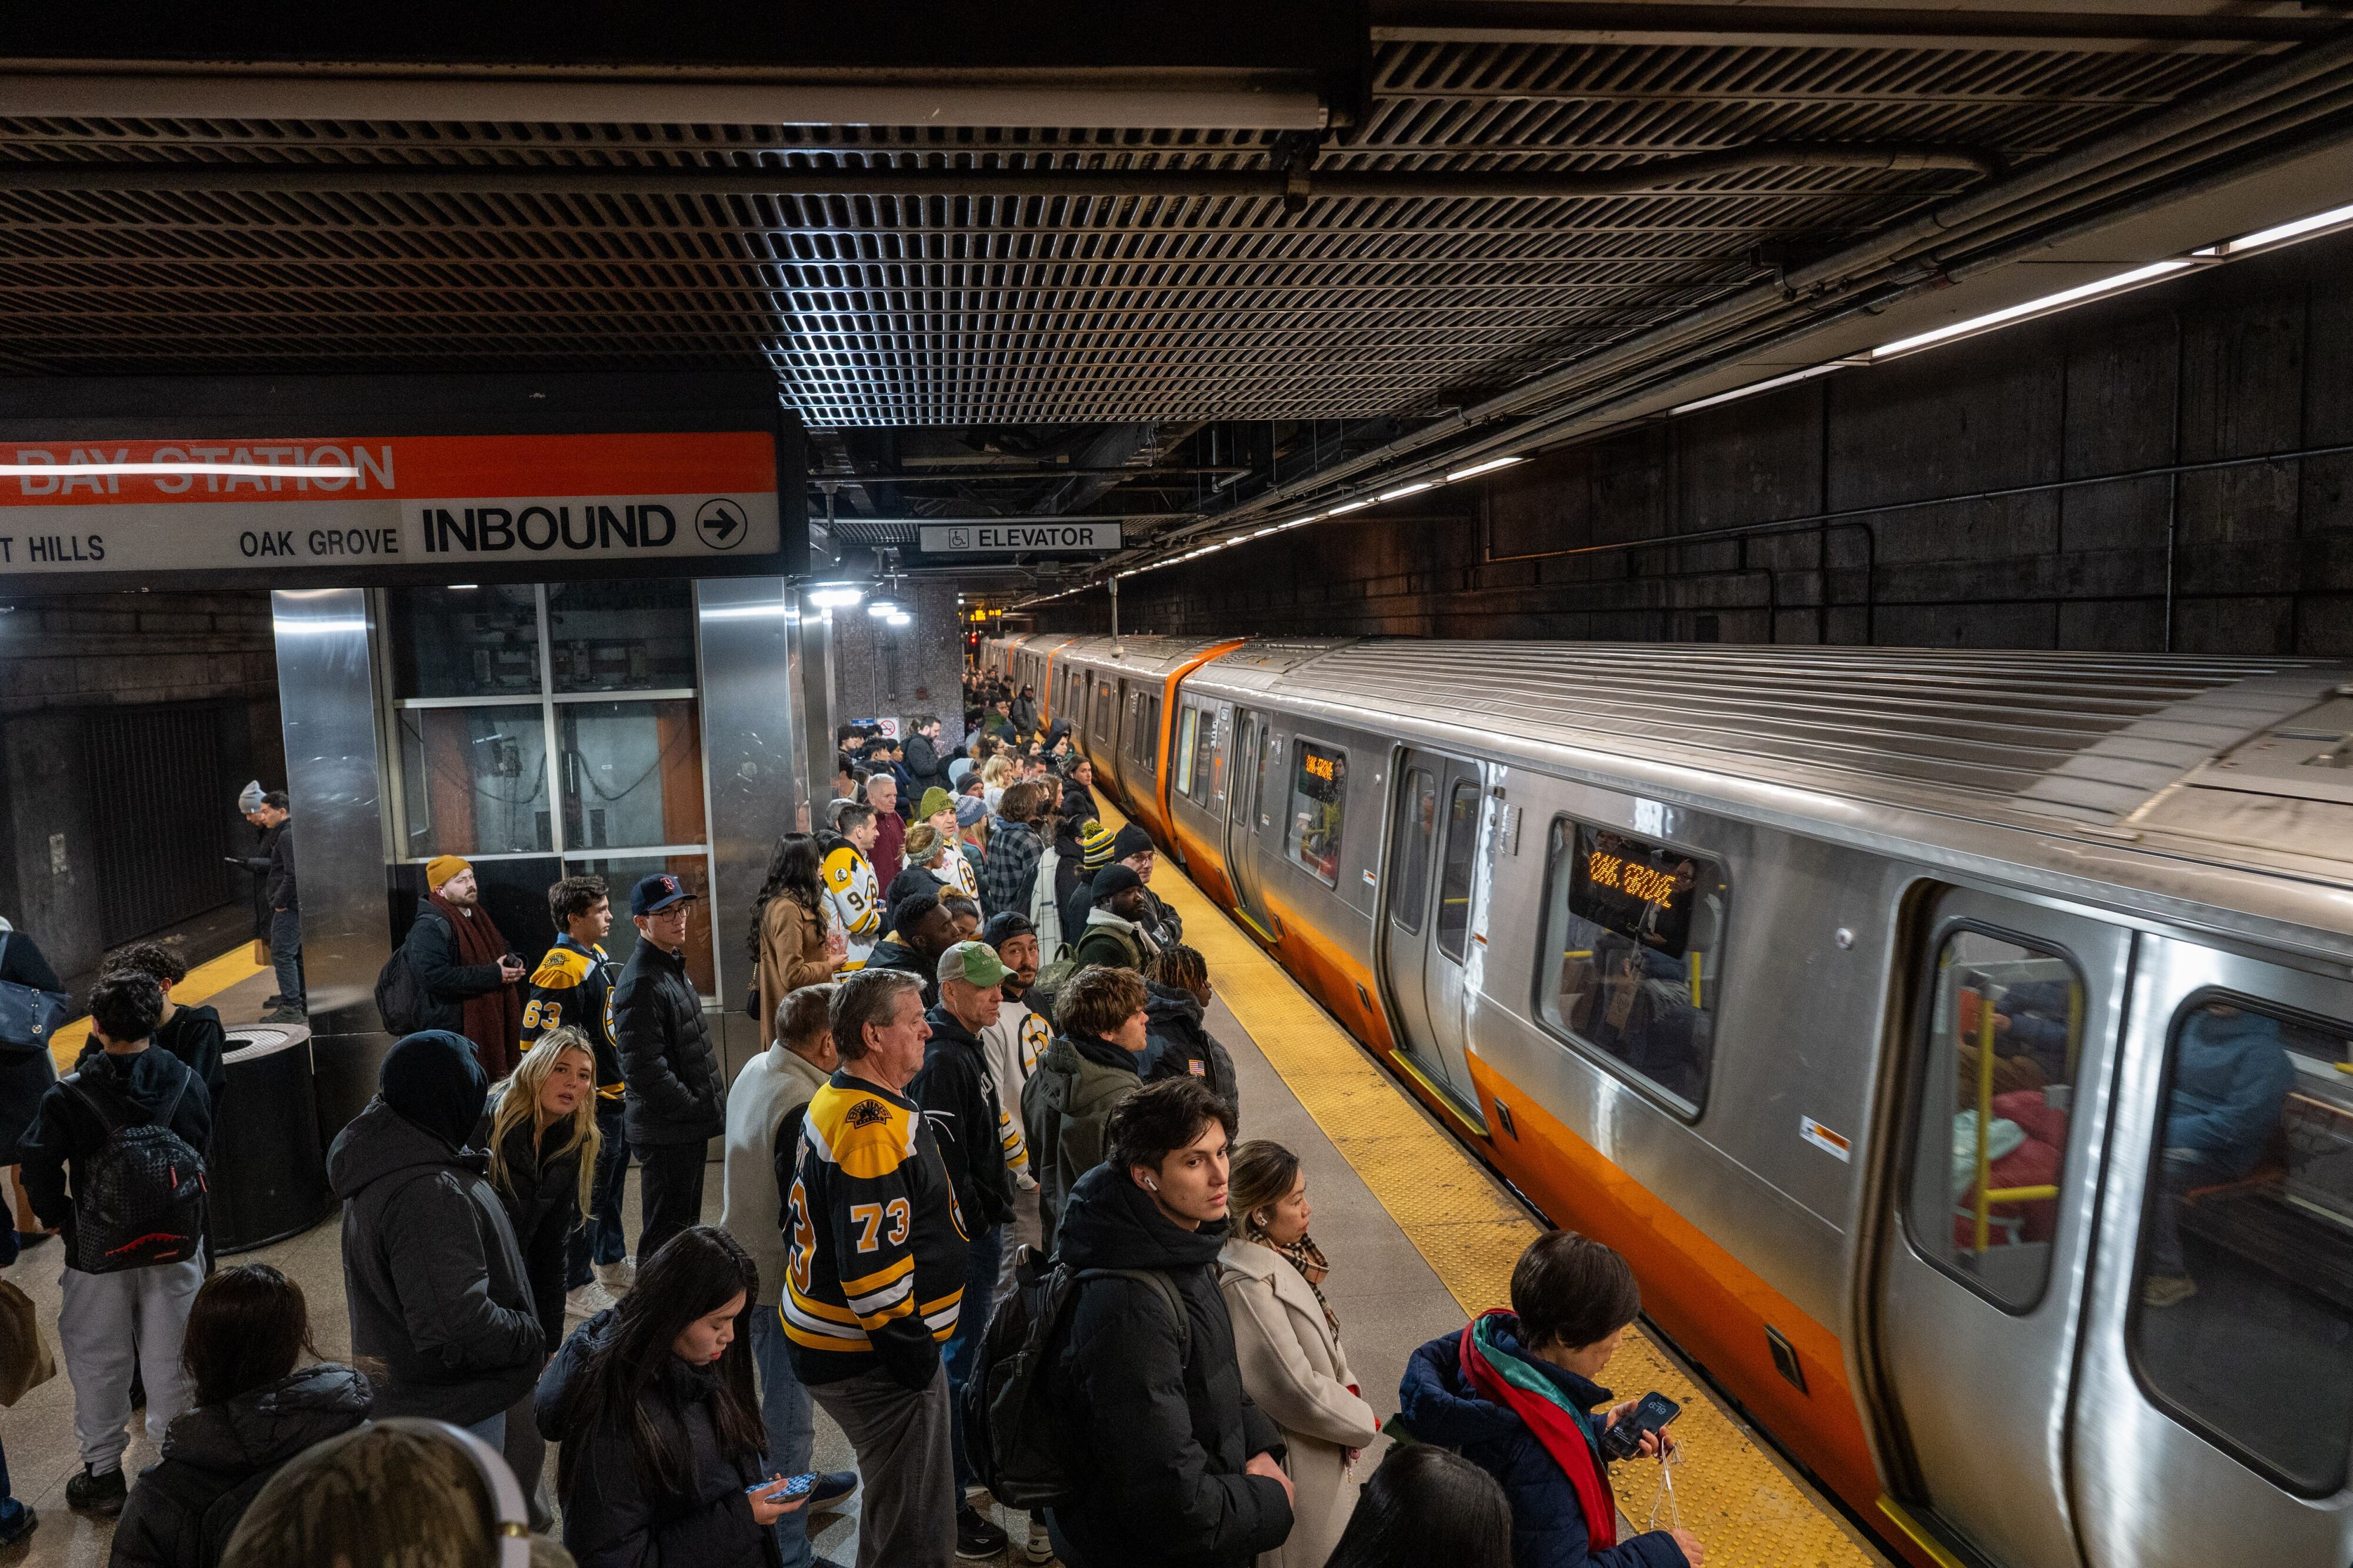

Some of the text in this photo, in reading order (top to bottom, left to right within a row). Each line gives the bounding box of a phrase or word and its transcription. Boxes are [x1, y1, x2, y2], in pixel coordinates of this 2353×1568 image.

[16, 445, 395, 495] BAY STATION
[422, 504, 676, 552] INBOUND
[979, 528, 1093, 546] ELEVATOR
[29, 535, 105, 562] HILLS
[240, 529, 399, 557] OAK GROVE
[847, 891, 865, 911] 9
[522, 999, 563, 1030] 63
[851, 1197, 910, 1254] 73
[1648, 1402, 1667, 1415] 6:19
